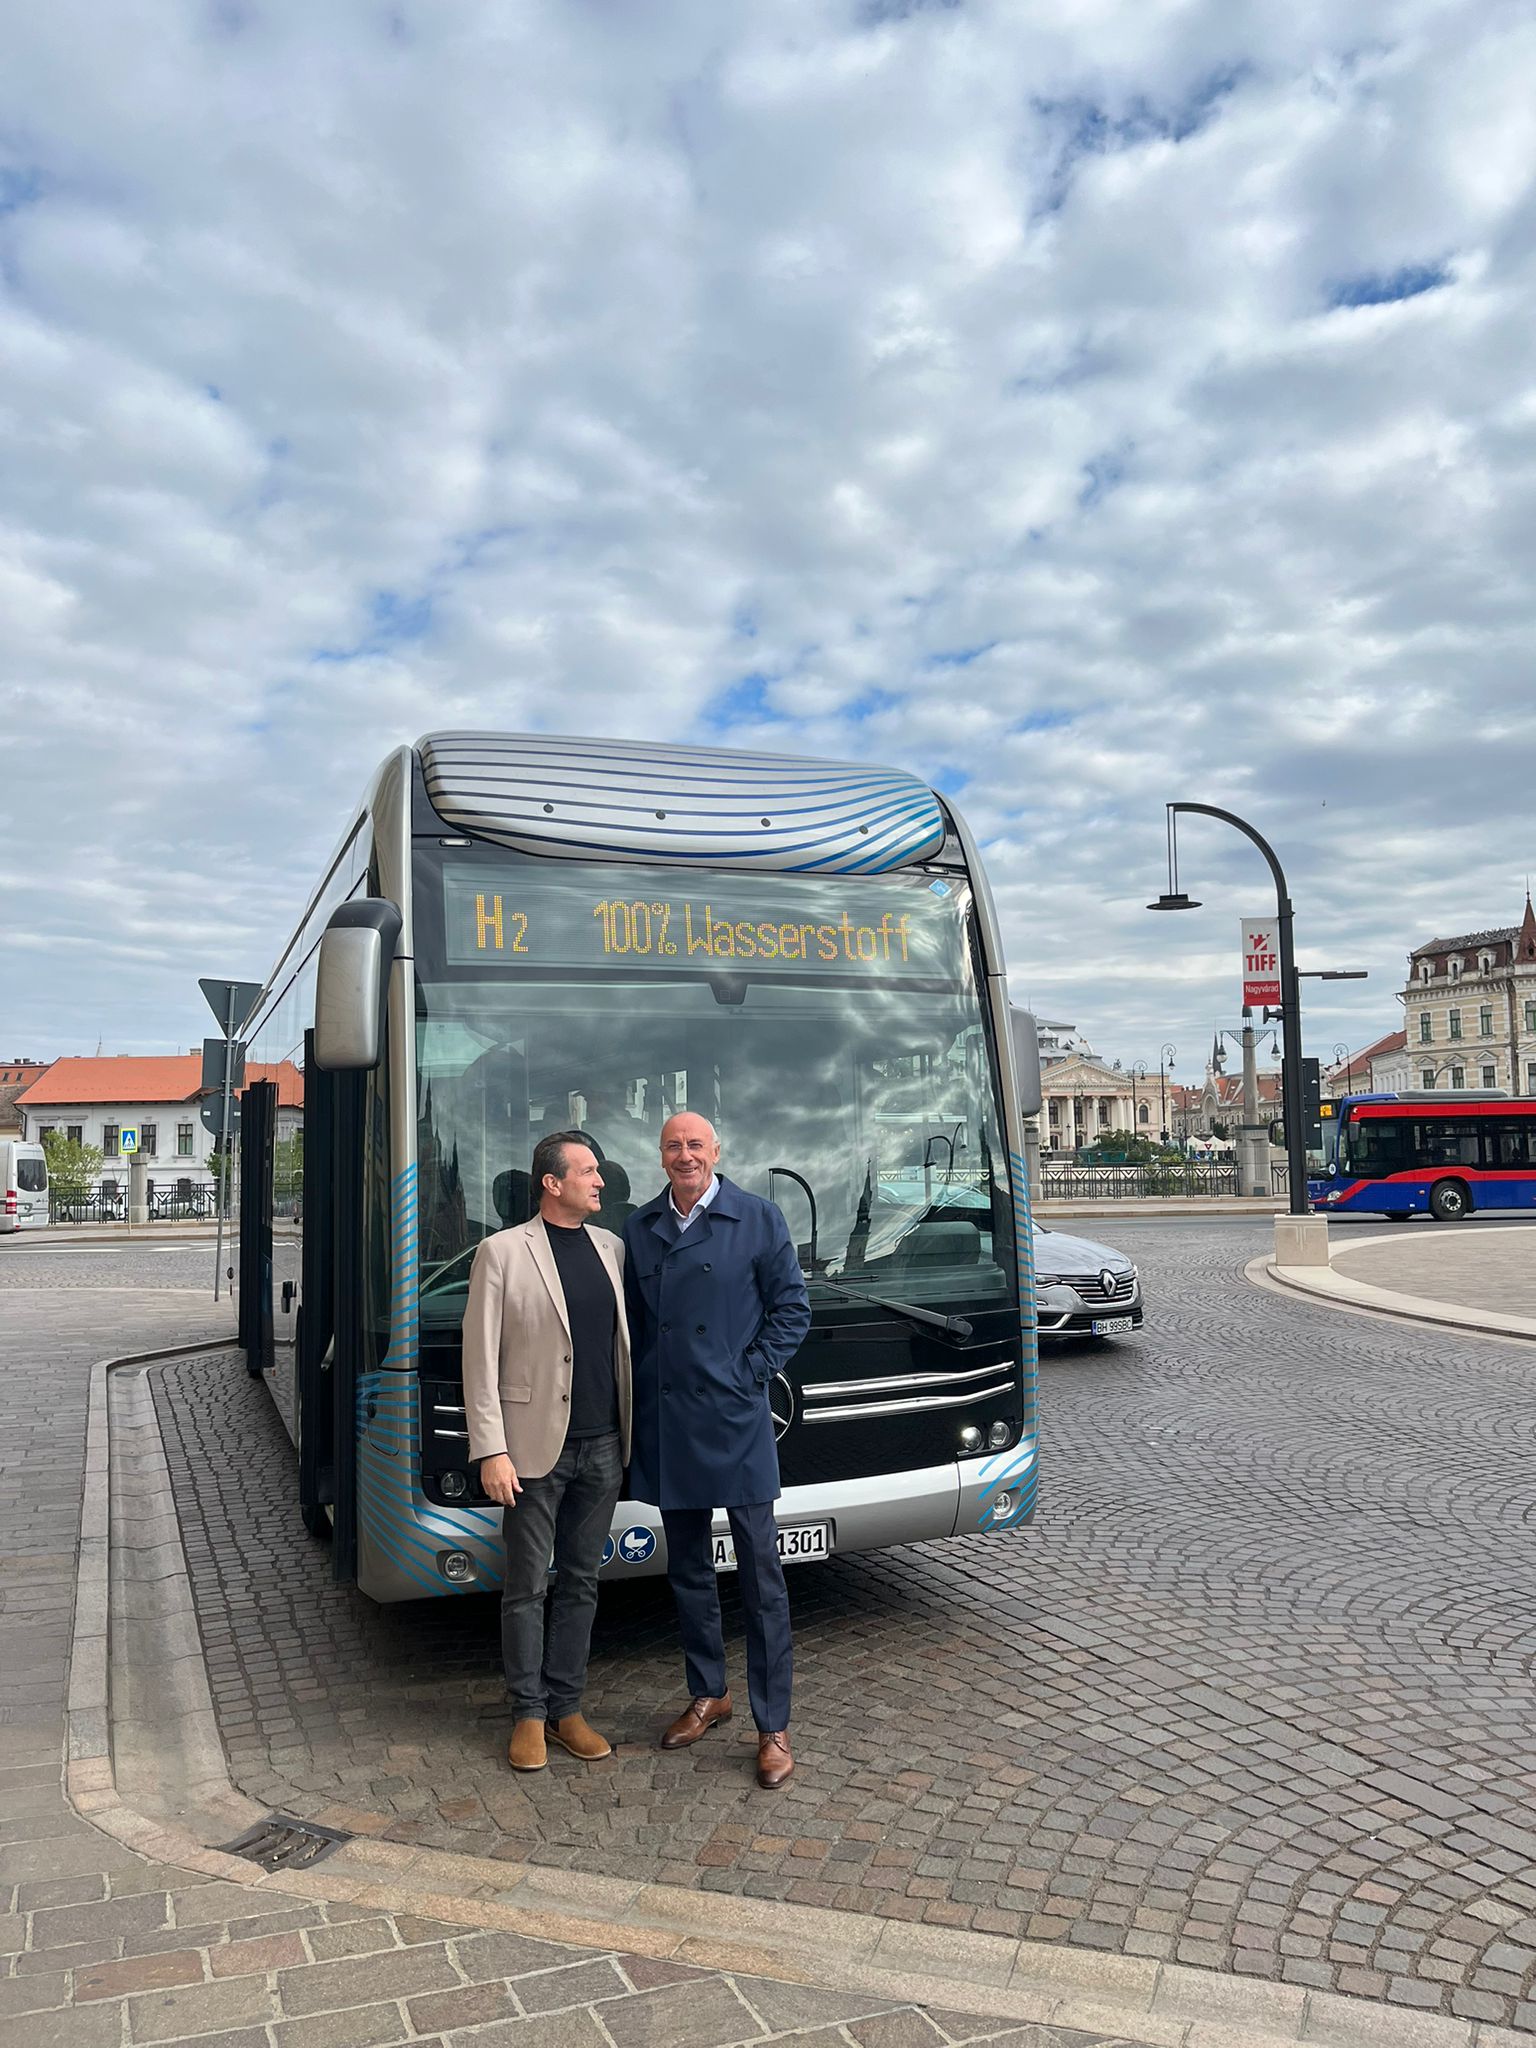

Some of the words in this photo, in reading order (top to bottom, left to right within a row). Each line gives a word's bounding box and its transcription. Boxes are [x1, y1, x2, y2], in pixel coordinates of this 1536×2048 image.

[593, 900, 678, 956] 100%
[685, 903, 912, 962] Wasserstoff
[1246, 954, 1276, 971] TIFF
[1097, 1322, 1108, 1332] BH
[776, 1529, 824, 1556] 1301
